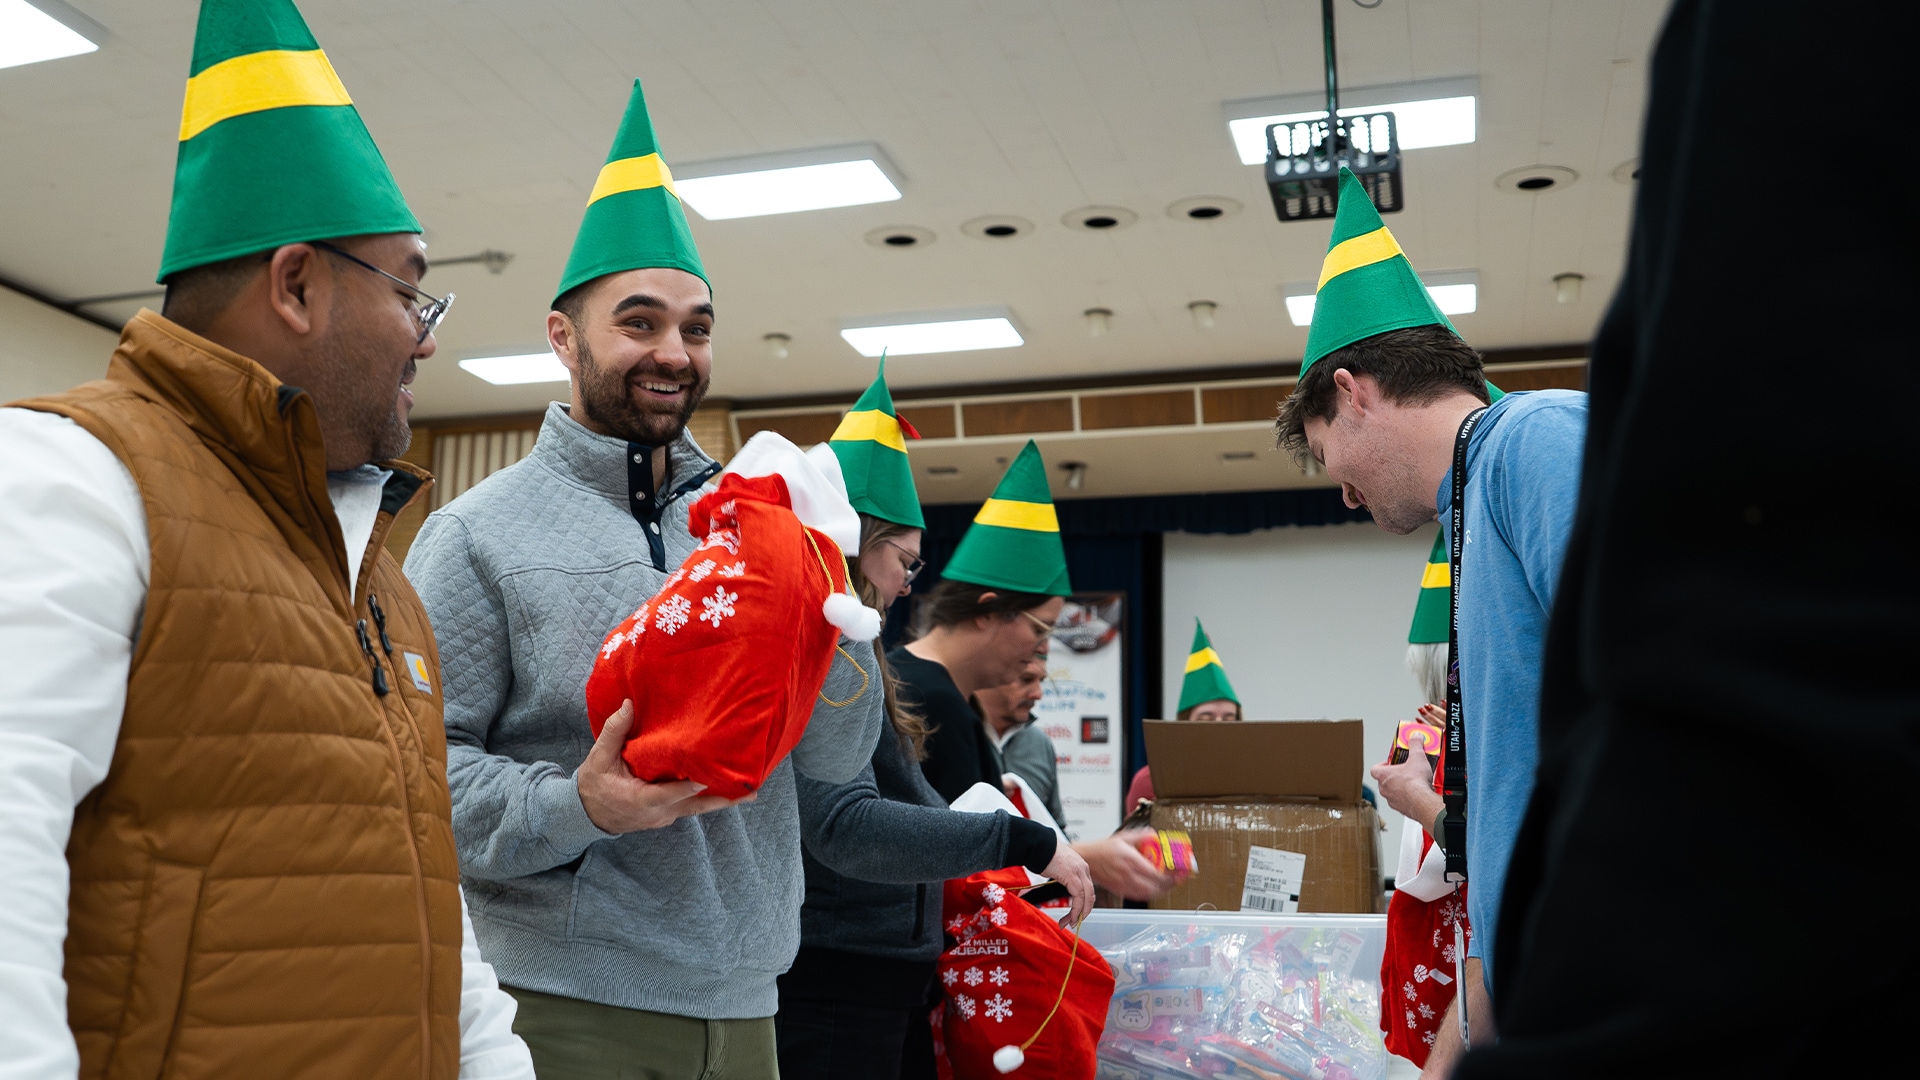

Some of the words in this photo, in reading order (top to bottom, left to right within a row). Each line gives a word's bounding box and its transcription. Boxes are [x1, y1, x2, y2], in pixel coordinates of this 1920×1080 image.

[1460, 421, 1474, 439] UTAH
[1451, 702, 1460, 724] JAZZ
[1450, 731, 1460, 752] UTAH
[973, 938, 1009, 947] MILLER
